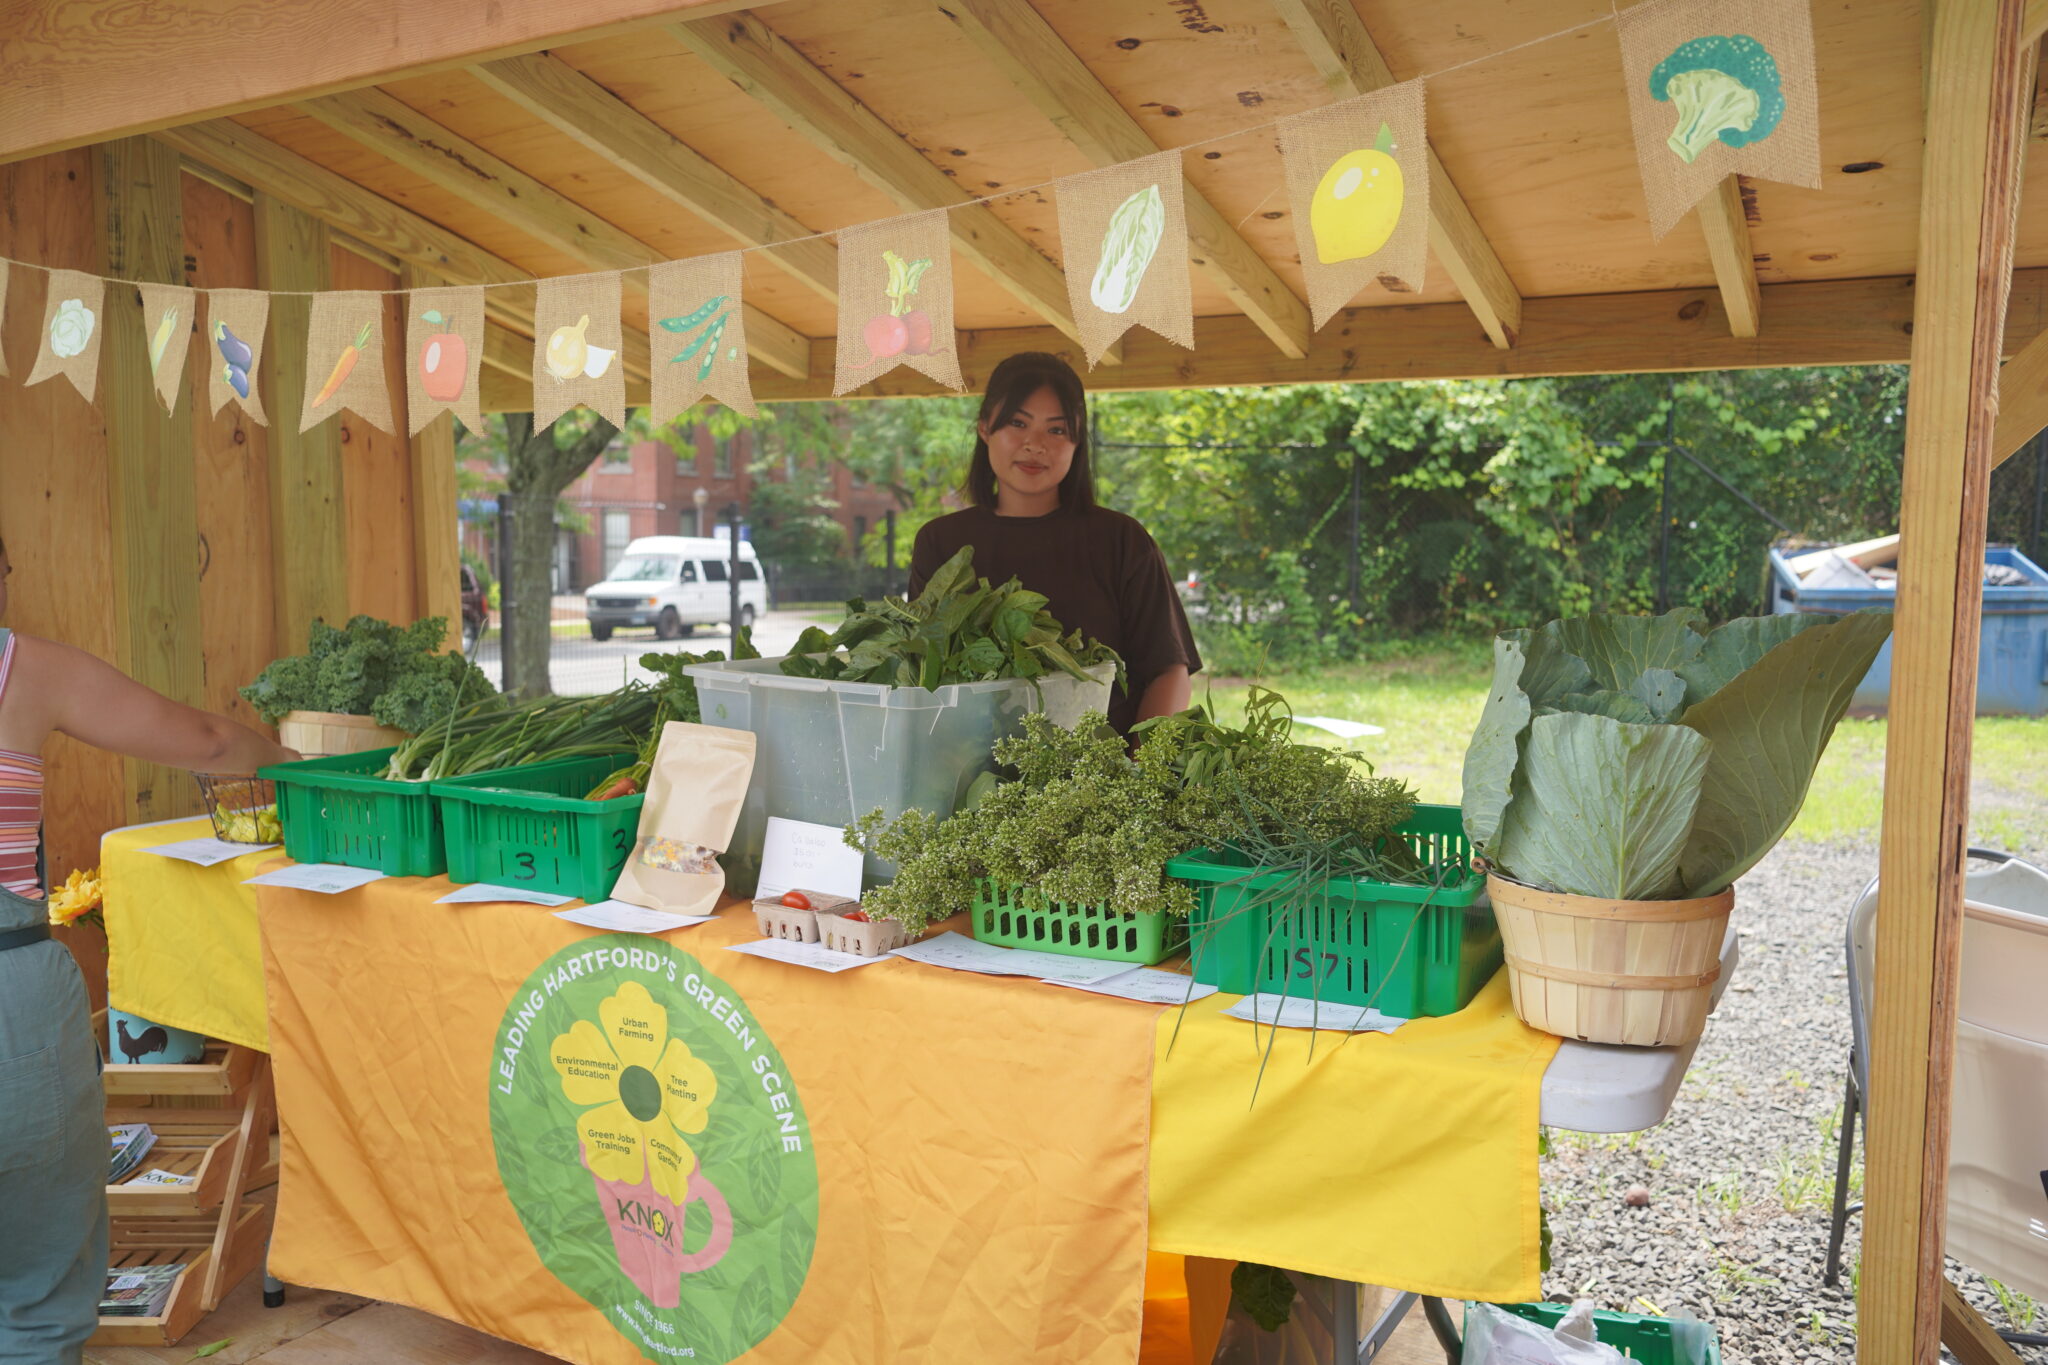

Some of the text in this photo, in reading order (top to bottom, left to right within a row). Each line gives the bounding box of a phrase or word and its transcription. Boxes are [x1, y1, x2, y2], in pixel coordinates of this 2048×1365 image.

[607, 828, 629, 871] 3
[514, 852, 537, 880] 3
[621, 1016, 649, 1030] Urban
[618, 1027, 655, 1042] Farming
[497, 988, 546, 1095] LEADING
[683, 972, 757, 1053] GREEN
[751, 1054, 803, 1154] SCENE
[556, 1055, 619, 1072] Environmental
[567, 1067, 611, 1081] Education
[670, 1074, 689, 1088] Tree
[588, 1129, 636, 1145] Green Jobs
[595, 1140, 631, 1155] Training
[617, 1198, 674, 1248] KNOX
[633, 1299, 675, 1335] SINCE 1966
